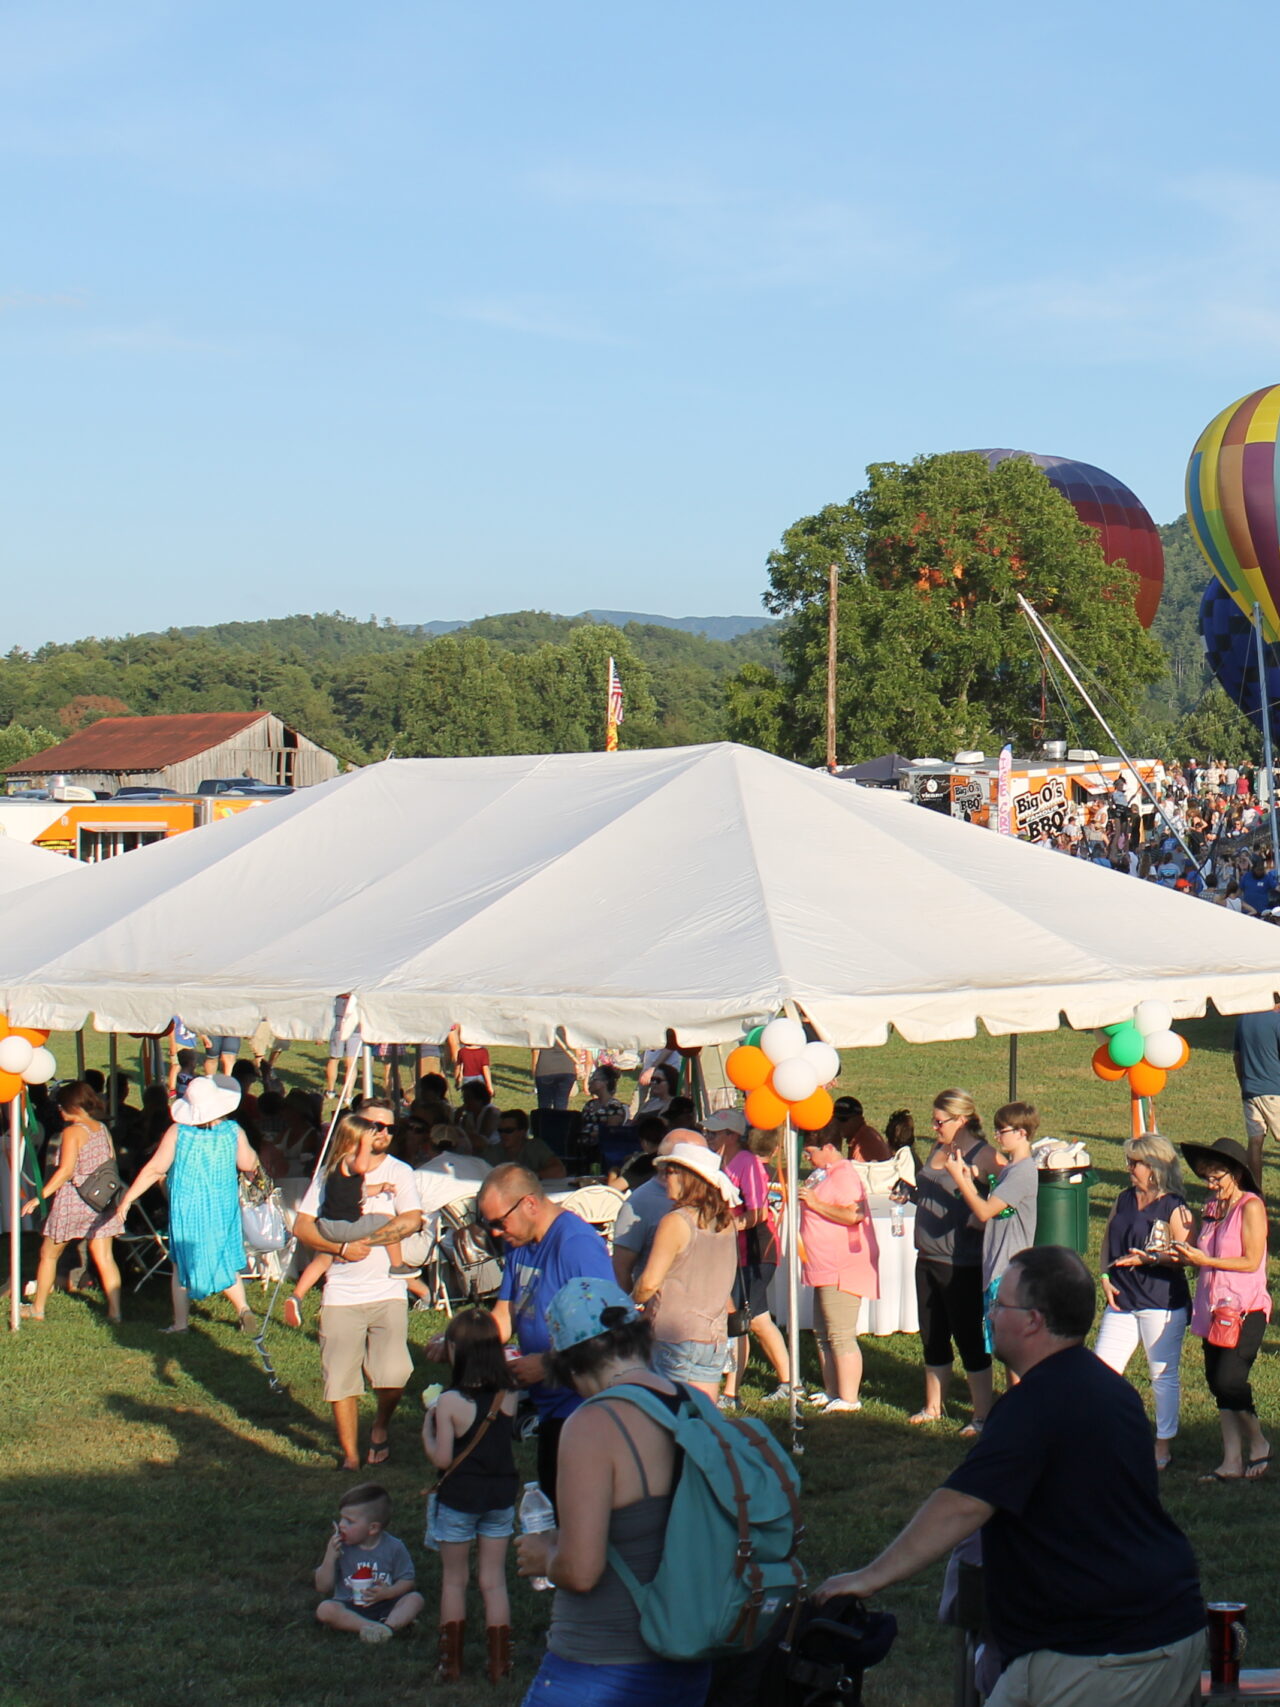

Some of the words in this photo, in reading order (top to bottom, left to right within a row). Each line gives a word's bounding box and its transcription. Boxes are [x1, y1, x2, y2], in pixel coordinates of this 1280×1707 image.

[960, 797, 979, 810] BBQ
[1016, 795, 1038, 814] Big
[1042, 781, 1062, 802] O's
[1027, 811, 1064, 840] BBQ
